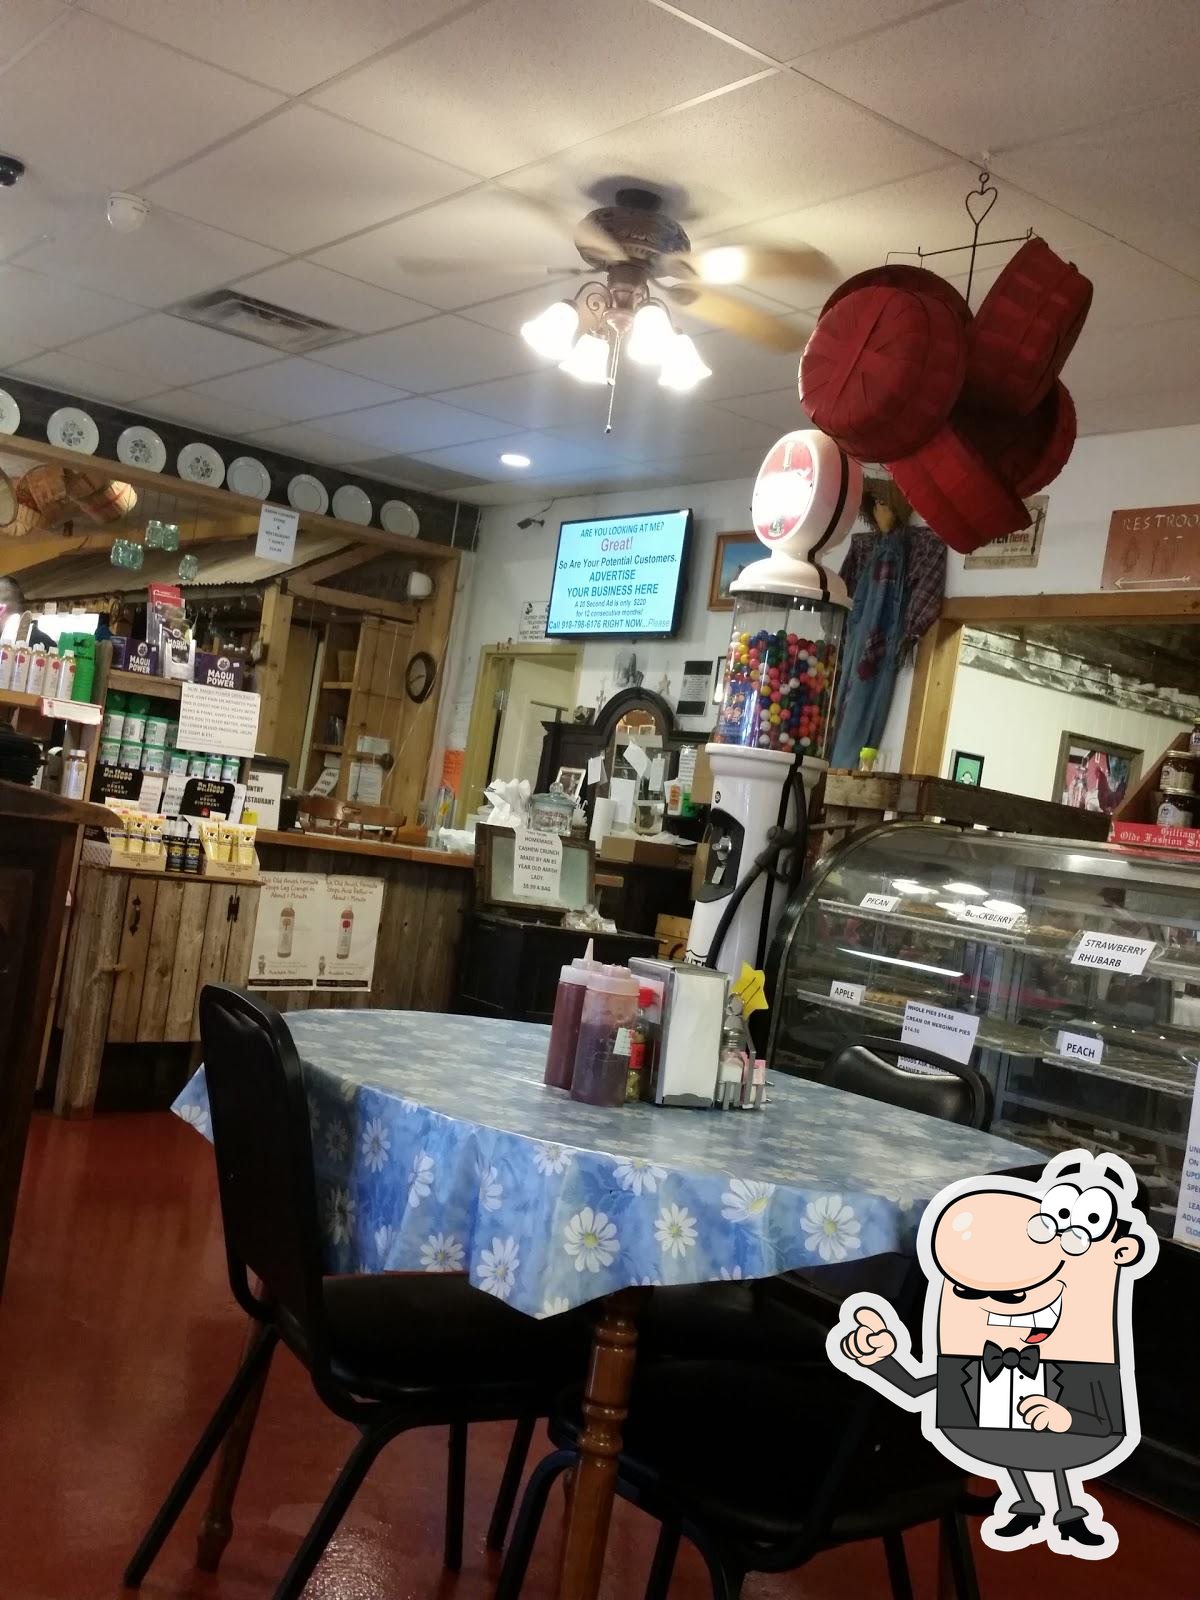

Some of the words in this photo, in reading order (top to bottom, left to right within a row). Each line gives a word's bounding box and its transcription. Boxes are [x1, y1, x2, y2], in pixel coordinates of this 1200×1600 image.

[1121, 513, 1200, 531] RESTROO
[580, 528, 593, 538] ARE
[594, 527, 607, 536] YOU
[608, 525, 638, 536] LOOKING
[639, 524, 648, 532] AT
[650, 522, 665, 531] ME?
[601, 536, 634, 552] Great!
[559, 560, 568, 570] So
[569, 560, 582, 569] Are
[583, 558, 600, 568] Your
[600, 556, 633, 567] Potential
[634, 554, 678, 564] Customers.
[589, 569, 636, 582] ADVERTISE
[567, 587, 590, 598] YOUR
[592, 585, 633, 597] BUSINESS
[634, 584, 659, 595] HERE
[586, 600, 606, 608] Second
[620, 600, 631, 608] only
[548, 620, 560, 629] Call
[602, 619, 624, 628] RIGHT
[130, 655, 151, 666] MAQUI
[128, 662, 151, 674] POWER
[208, 669, 234, 680] MAQUI
[206, 678, 234, 688] POWER
[1121, 831, 1140, 842] Olde
[1144, 832, 1182, 845] Fashion
[540, 848, 560, 856] CRUNCH
[866, 896, 890, 906] PECAN
[965, 910, 1014, 924] BLCKBERRY
[1085, 939, 1147, 956] STRAWBERRY
[1078, 954, 1122, 967] RHUBARB
[834, 987, 855, 1000] APPLE
[908, 1005, 925, 1013] WHOLE
[906, 1016, 923, 1024] CREAM
[958, 1028, 970, 1036] PIES
[1066, 1042, 1096, 1058] PEACH
[1190, 1146, 1200, 1154] UN
[1189, 1158, 1199, 1166] ON
[1186, 1170, 1200, 1180] UPO
[1186, 1184, 1200, 1193] SPE
[1189, 1202, 1200, 1210] LEA
[1182, 1213, 1200, 1224] ADVA
